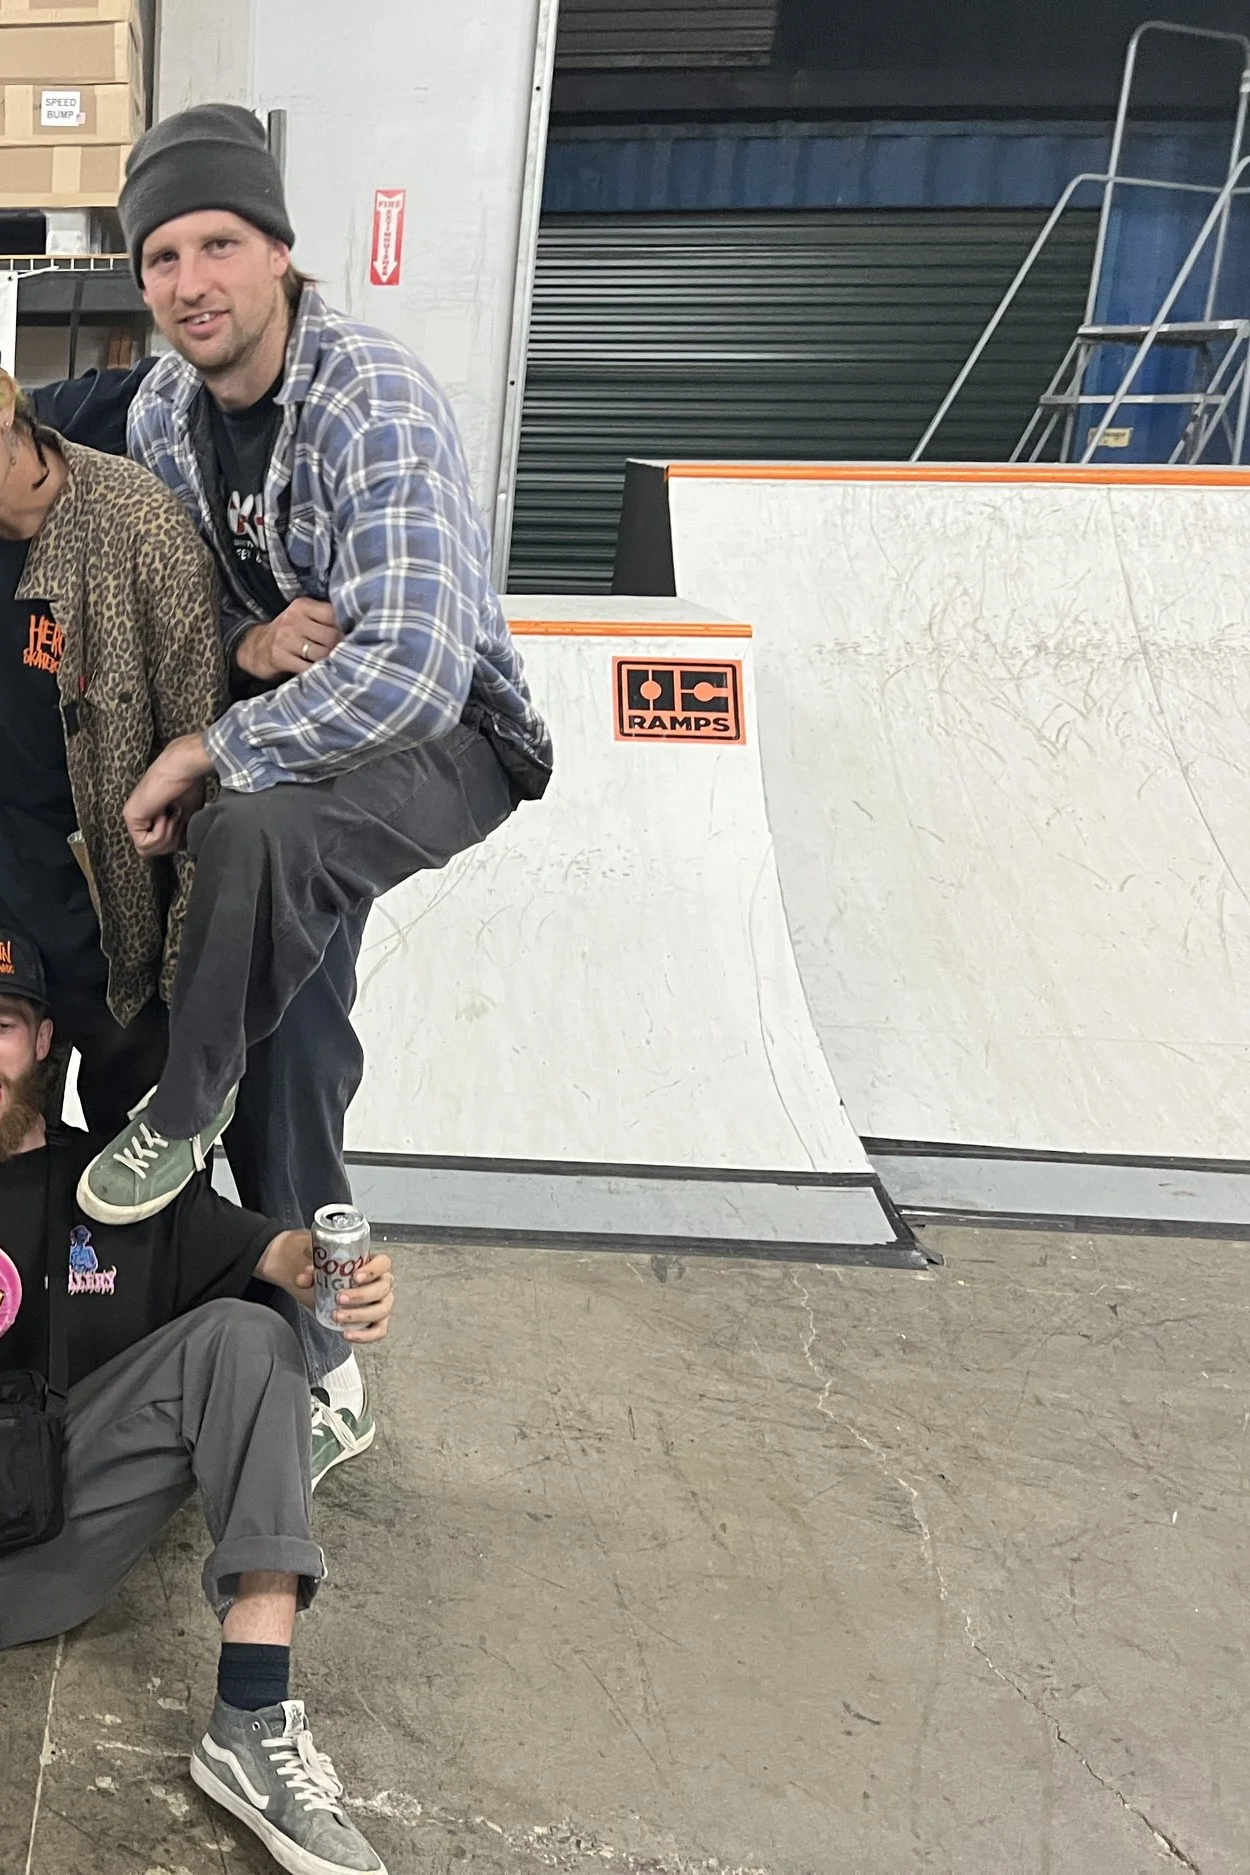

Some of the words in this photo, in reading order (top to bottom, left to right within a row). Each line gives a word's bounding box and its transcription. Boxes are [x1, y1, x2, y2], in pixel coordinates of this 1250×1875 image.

[45, 98, 77, 107] SPEED
[46, 111, 74, 119] BUMP
[378, 200, 401, 208] FIRE
[29, 614, 64, 658] HER
[628, 715, 730, 732] RAMPS
[313, 1246, 367, 1277] Coo
